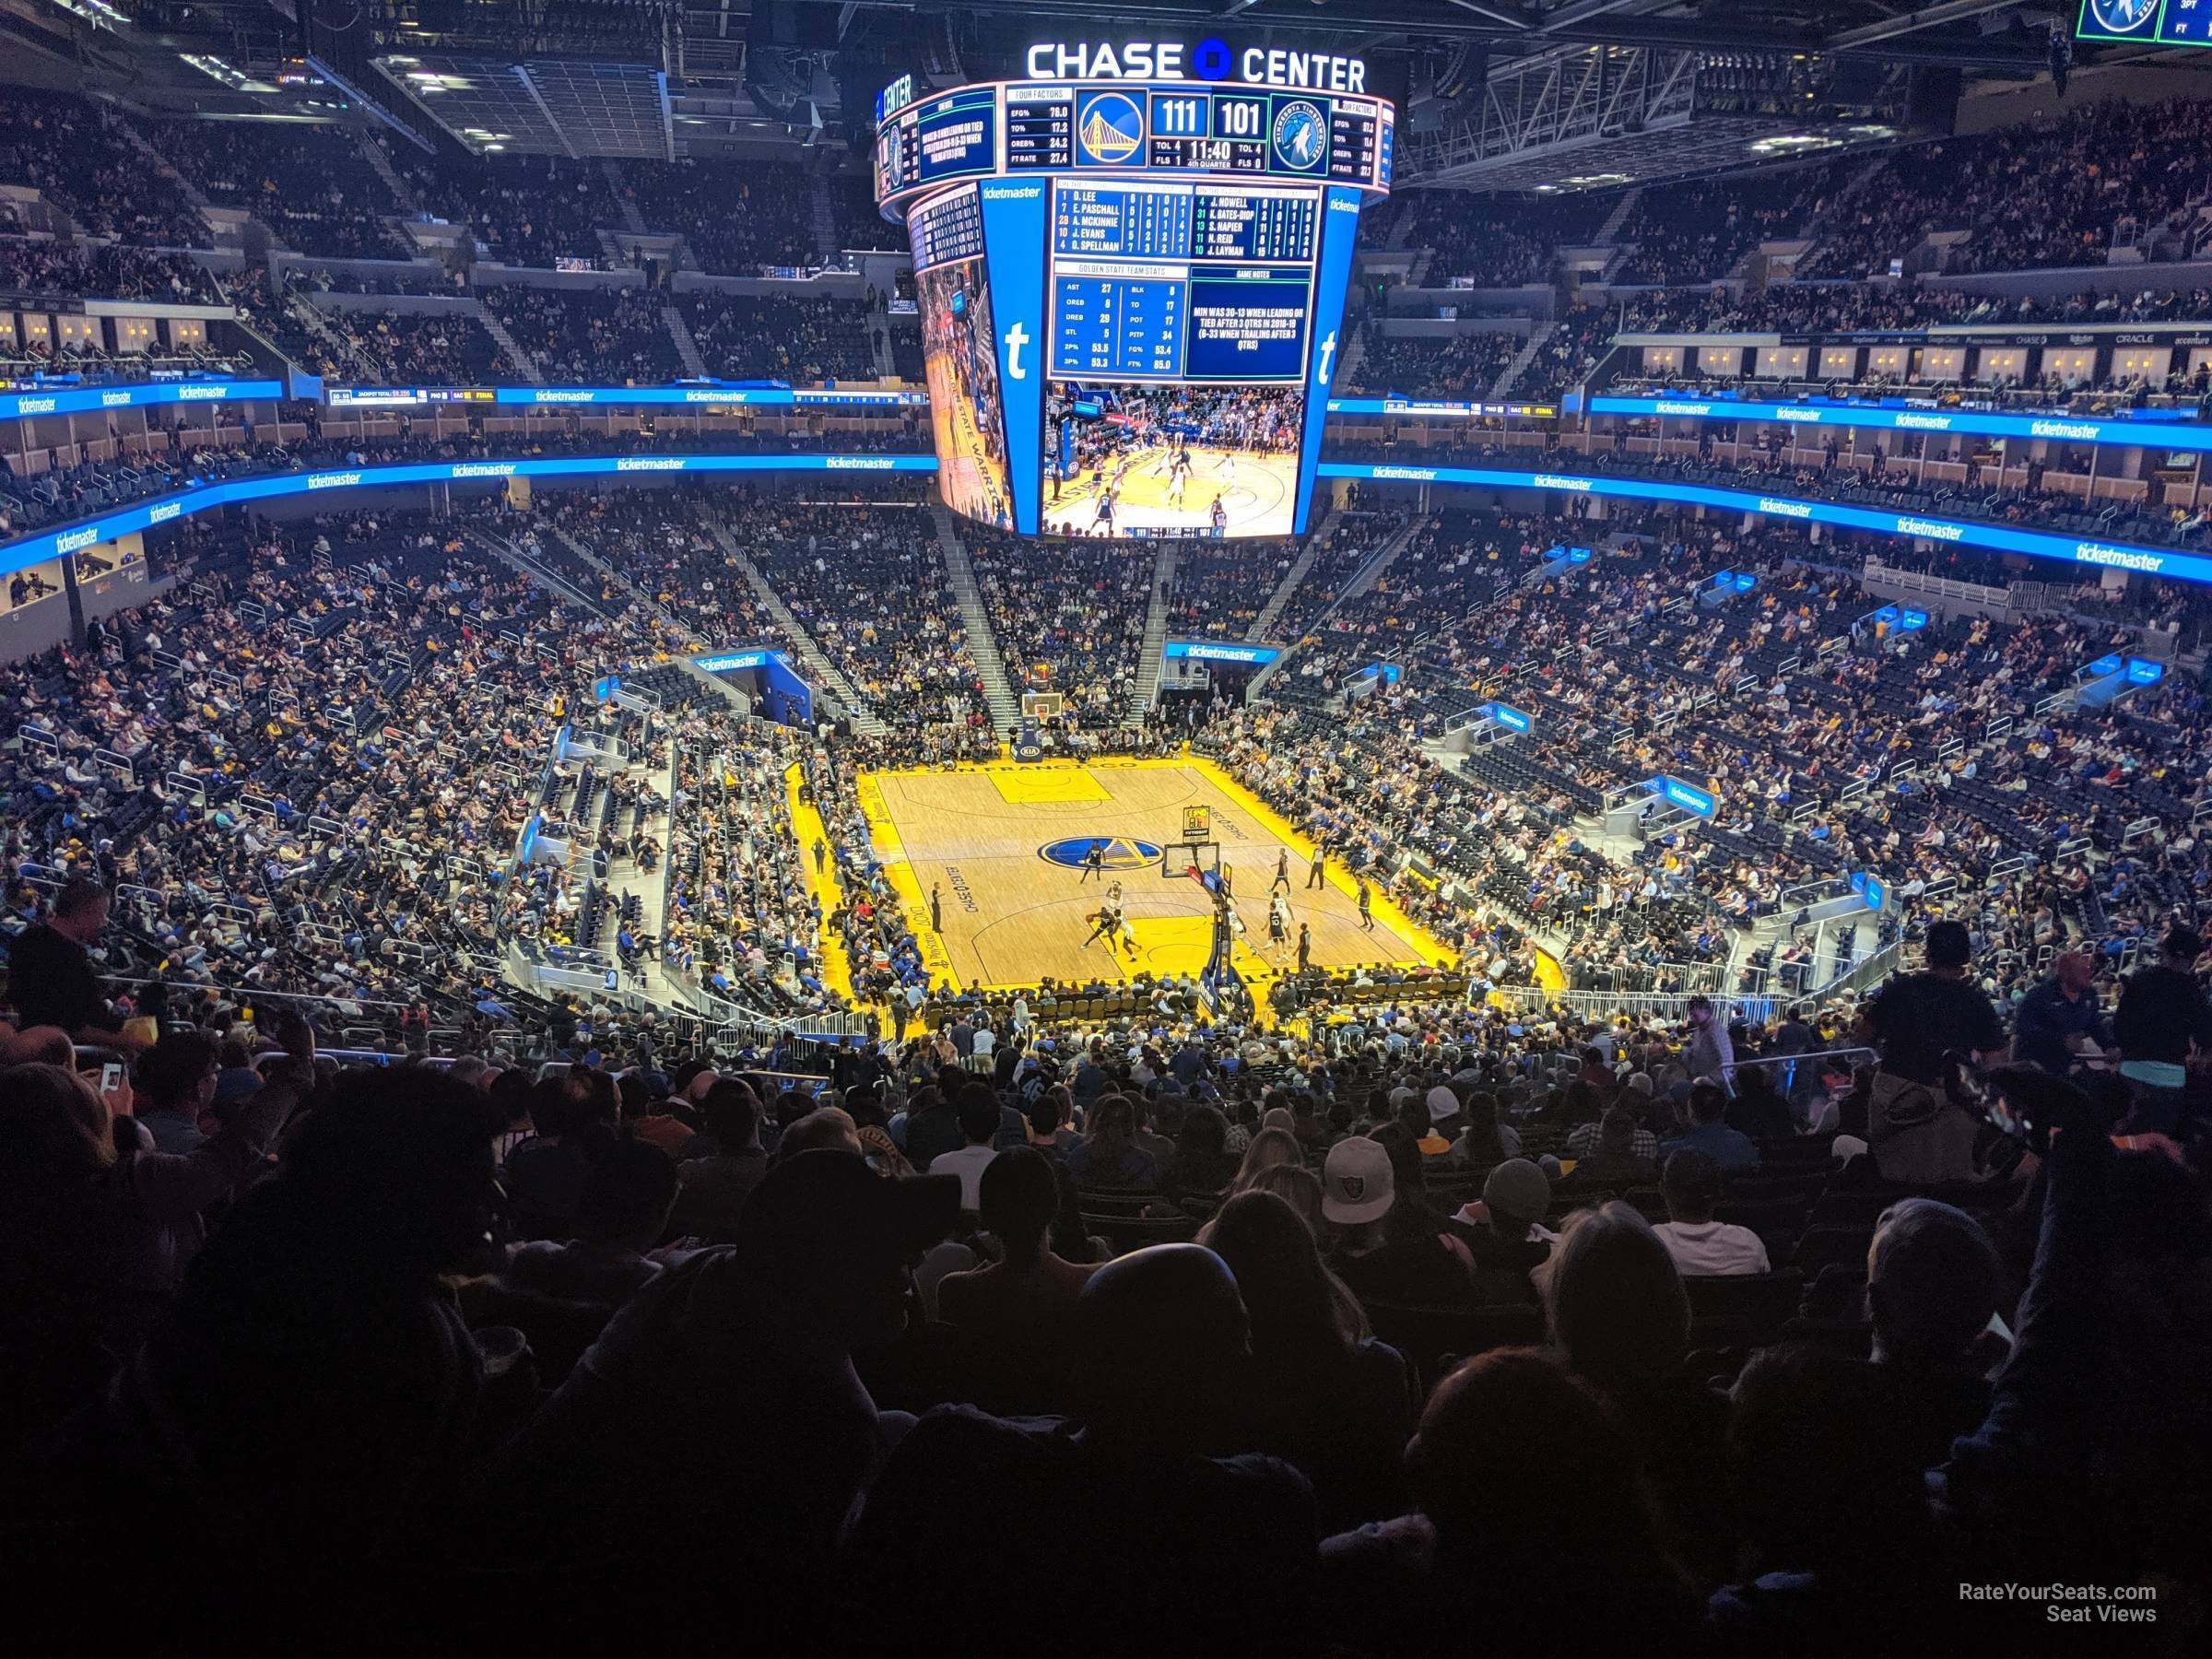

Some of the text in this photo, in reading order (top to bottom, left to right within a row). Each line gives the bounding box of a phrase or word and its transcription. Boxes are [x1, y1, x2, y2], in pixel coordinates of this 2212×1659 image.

[2176, 24, 2187, 34] FT
[1028, 43, 1365, 93] CHASE CENTER
[884, 74, 911, 117] CENTER
[1016, 90, 1031, 99] FOUR
[1163, 100, 1259, 135] 111 101
[1052, 123, 1067, 133] 17.2
[1277, 105, 1324, 159] MINNESOTA TIMBERWOLVES
[1050, 138, 1067, 148] 24.2
[1175, 140, 1181, 150] 4
[1191, 140, 1230, 159] 11:40
[1239, 144, 1261, 154] TOL 4
[1051, 154, 1067, 163] 27.4
[1176, 156, 1180, 165] 1
[1239, 159, 1260, 169] FLS 0
[984, 187, 1041, 199] ticketmaster
[1083, 192, 1096, 201] LEE
[1211, 197, 1248, 207] J. NOWELL
[1074, 204, 1120, 215] E. PASCHALL
[1198, 210, 1254, 220] 31 K. BATES-DIOP
[1073, 216, 1118, 228] A. MCKINNIE
[1197, 221, 1242, 232] 13 S. NAPIER
[1073, 229, 1079, 238] J.
[1081, 229, 1105, 239] EVANS
[1196, 234, 1233, 243] 11 N. REID
[1080, 241, 1119, 251] SPELLMAN
[1207, 246, 1215, 255] J.
[1216, 246, 1244, 256] LAYMAN
[1079, 265, 1166, 275] GOLDEN STATE TEAM STATS
[1101, 284, 1112, 293] 27
[1166, 301, 1174, 311] 17
[1209, 307, 1225, 317] WAS
[1226, 308, 1245, 317] 30-13
[1246, 309, 1266, 317] WHEN
[1267, 309, 1293, 317] LEADING
[1295, 309, 1303, 317] OR
[1165, 316, 1173, 325] 17
[1201, 319, 1216, 327] TIED
[1217, 319, 1238, 328] AFTER
[1239, 319, 1243, 328] 3
[1244, 319, 1262, 329] QTRS
[1264, 319, 1269, 328] IN
[1104, 329, 1109, 338] 5
[1219, 330, 1240, 338] WHEN
[1241, 330, 1270, 338] TRAILING
[1271, 330, 1290, 339] AFTER
[1291, 330, 1296, 338] 3
[2116, 335, 2154, 344] ORACLE
[2174, 336, 2210, 345] accenture
[1005, 322, 1030, 380] t
[1155, 345, 1171, 354] 53.4
[1238, 340, 1258, 351] QTRS)
[1091, 358, 1108, 367] 53.3
[1319, 330, 1335, 385] t
[179, 383, 228, 398] ticketmaster
[535, 390, 594, 402] ticketmaster
[102, 391, 131, 406] ticketmaster
[686, 391, 747, 402] ticketmaster
[18, 396, 56, 413] ticketmaster
[1655, 402, 1712, 415] ticketmaster
[1775, 407, 1821, 421] ticketmaster
[1895, 413, 1951, 429] ticketmaster
[2031, 420, 2100, 439] ticketmaster
[617, 457, 687, 470] ticketmaster
[826, 456, 895, 469] ticketmaster
[452, 463, 516, 477] ticketmaster
[1372, 465, 1437, 480] ticketmaster
[307, 473, 361, 488] ticketmaster
[1534, 475, 1594, 491] ticketmaster
[150, 501, 182, 524] ticketmaster
[1759, 498, 1812, 518] ticketmaster
[1896, 517, 1963, 541] ticketmaster
[55, 527, 99, 554] ticketmaster
[2076, 543, 2164, 571] ticketmaster
[1187, 645, 1256, 662] ticketmaster
[984, 761, 1137, 772] FRANCISCO
[1670, 786, 1708, 810] ticketmaster
[946, 866, 979, 912] CHASE CENTER
